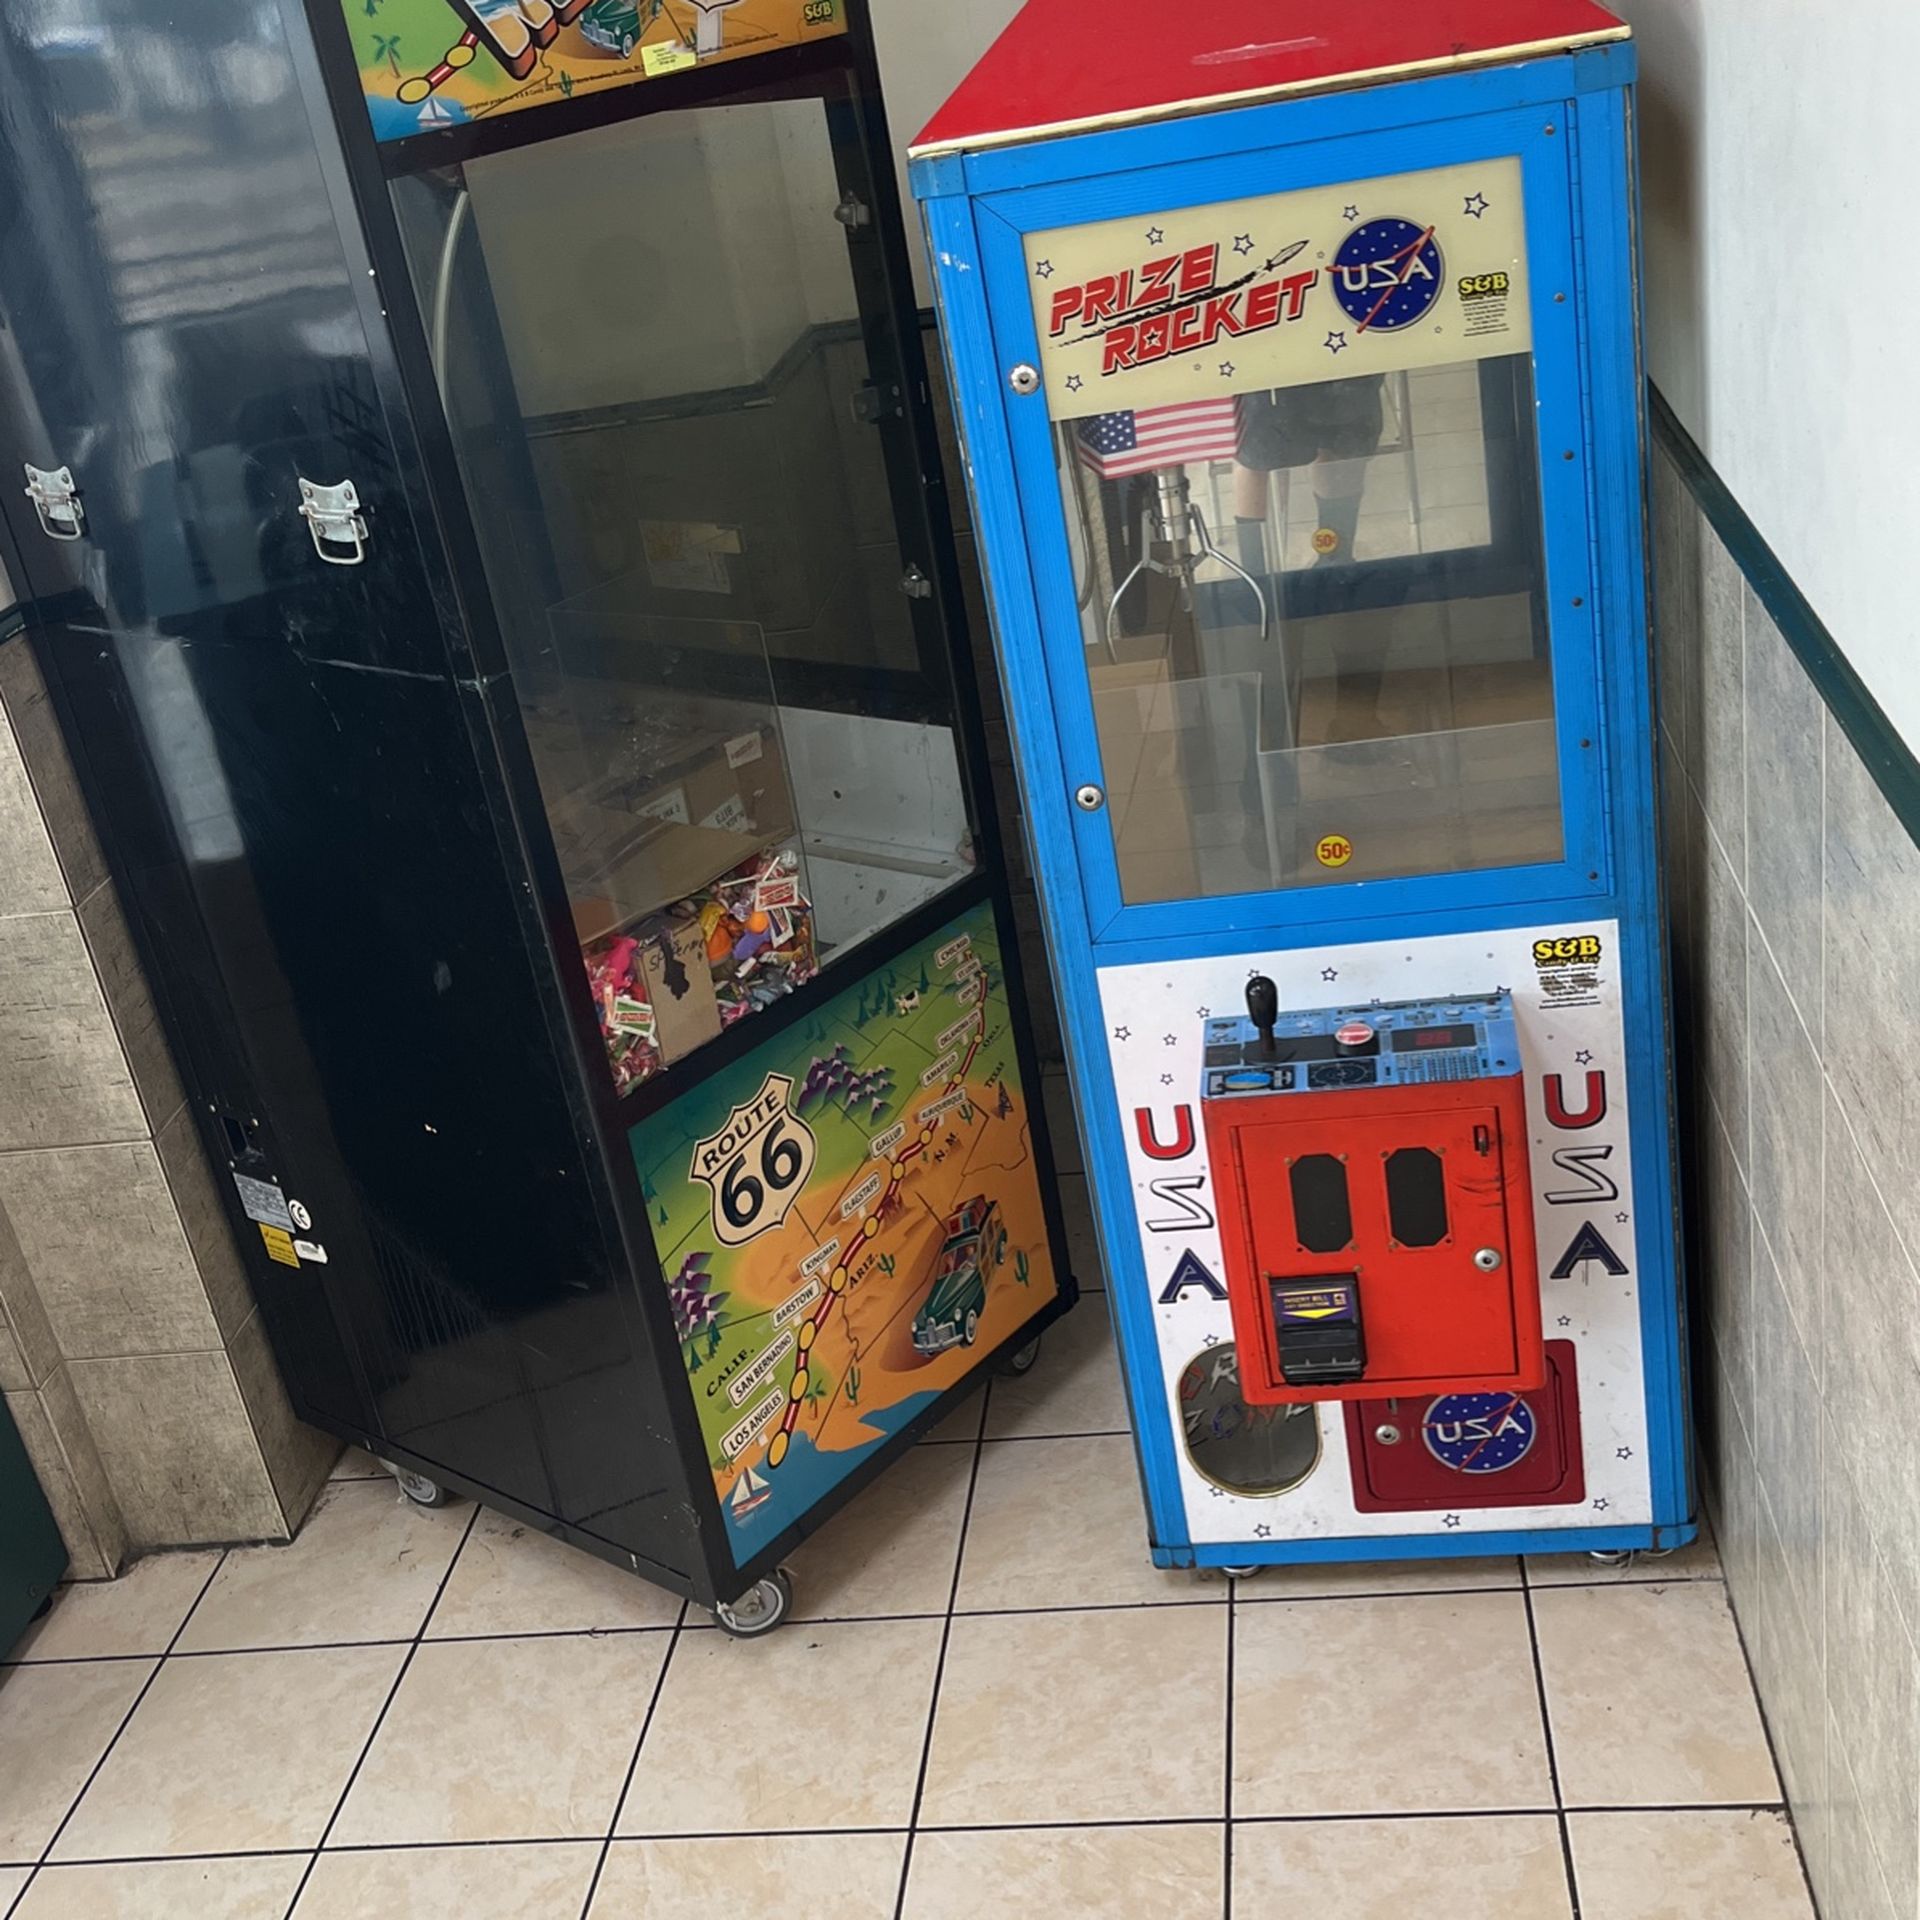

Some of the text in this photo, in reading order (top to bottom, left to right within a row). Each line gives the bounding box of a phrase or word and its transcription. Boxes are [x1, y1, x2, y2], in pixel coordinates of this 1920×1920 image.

[804, 1, 832, 20] S&B
[1050, 243, 1218, 337] PRIZE
[1342, 255, 1434, 292] USA
[1459, 273, 1509, 296] S&B
[1102, 269, 1319, 376] ROCKET
[1321, 843, 1351, 859] 50¢
[1532, 935, 1601, 960] S&B
[925, 1054, 957, 1082] AMARILLO
[984, 1061, 1005, 1088] TEXAS
[702, 1090, 781, 1172] ROUTE
[875, 1126, 902, 1151] GALLUP
[722, 1117, 803, 1228] 66
[844, 1178, 878, 1212] FLAGSTAFF
[805, 1242, 838, 1270] KINGMAN
[849, 1253, 878, 1288] ARIZ.
[775, 1287, 814, 1323] BARSTOW
[707, 1348, 755, 1397] CALIF.
[734, 1334, 792, 1398] SAN BERNADINO
[729, 1393, 782, 1452] LOS ANGELES
[1436, 1414, 1526, 1443] USA
